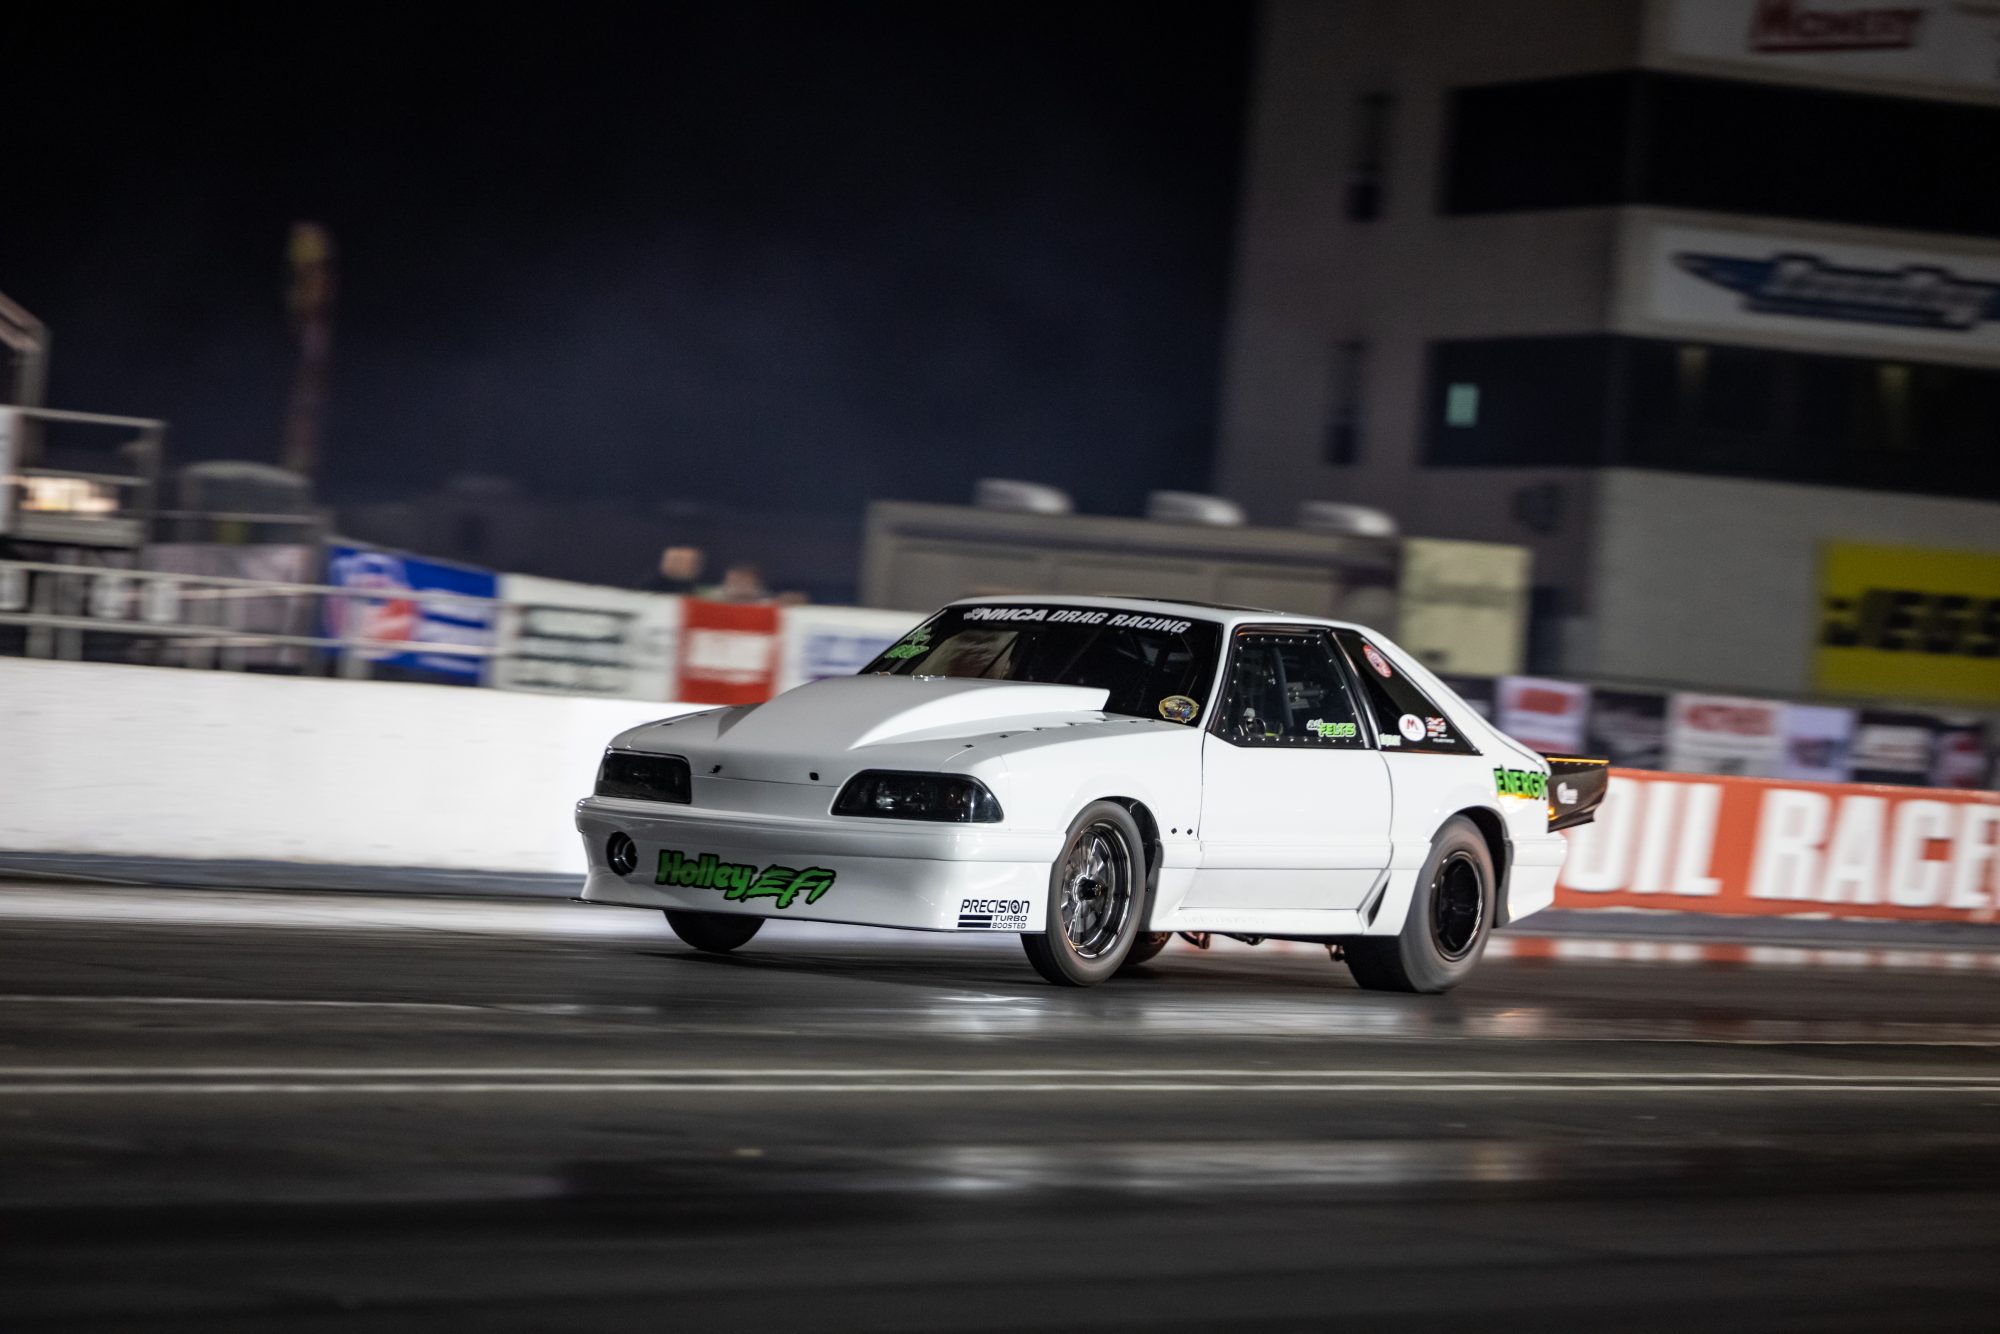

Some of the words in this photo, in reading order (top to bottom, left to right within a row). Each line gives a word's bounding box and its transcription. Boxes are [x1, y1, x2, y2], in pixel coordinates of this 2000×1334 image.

[973, 608, 1049, 622] NMCA
[1046, 609, 1109, 624] DRAG
[1107, 613, 1192, 634] RACING
[655, 849, 757, 901] Holley
[745, 864, 836, 909] EFI
